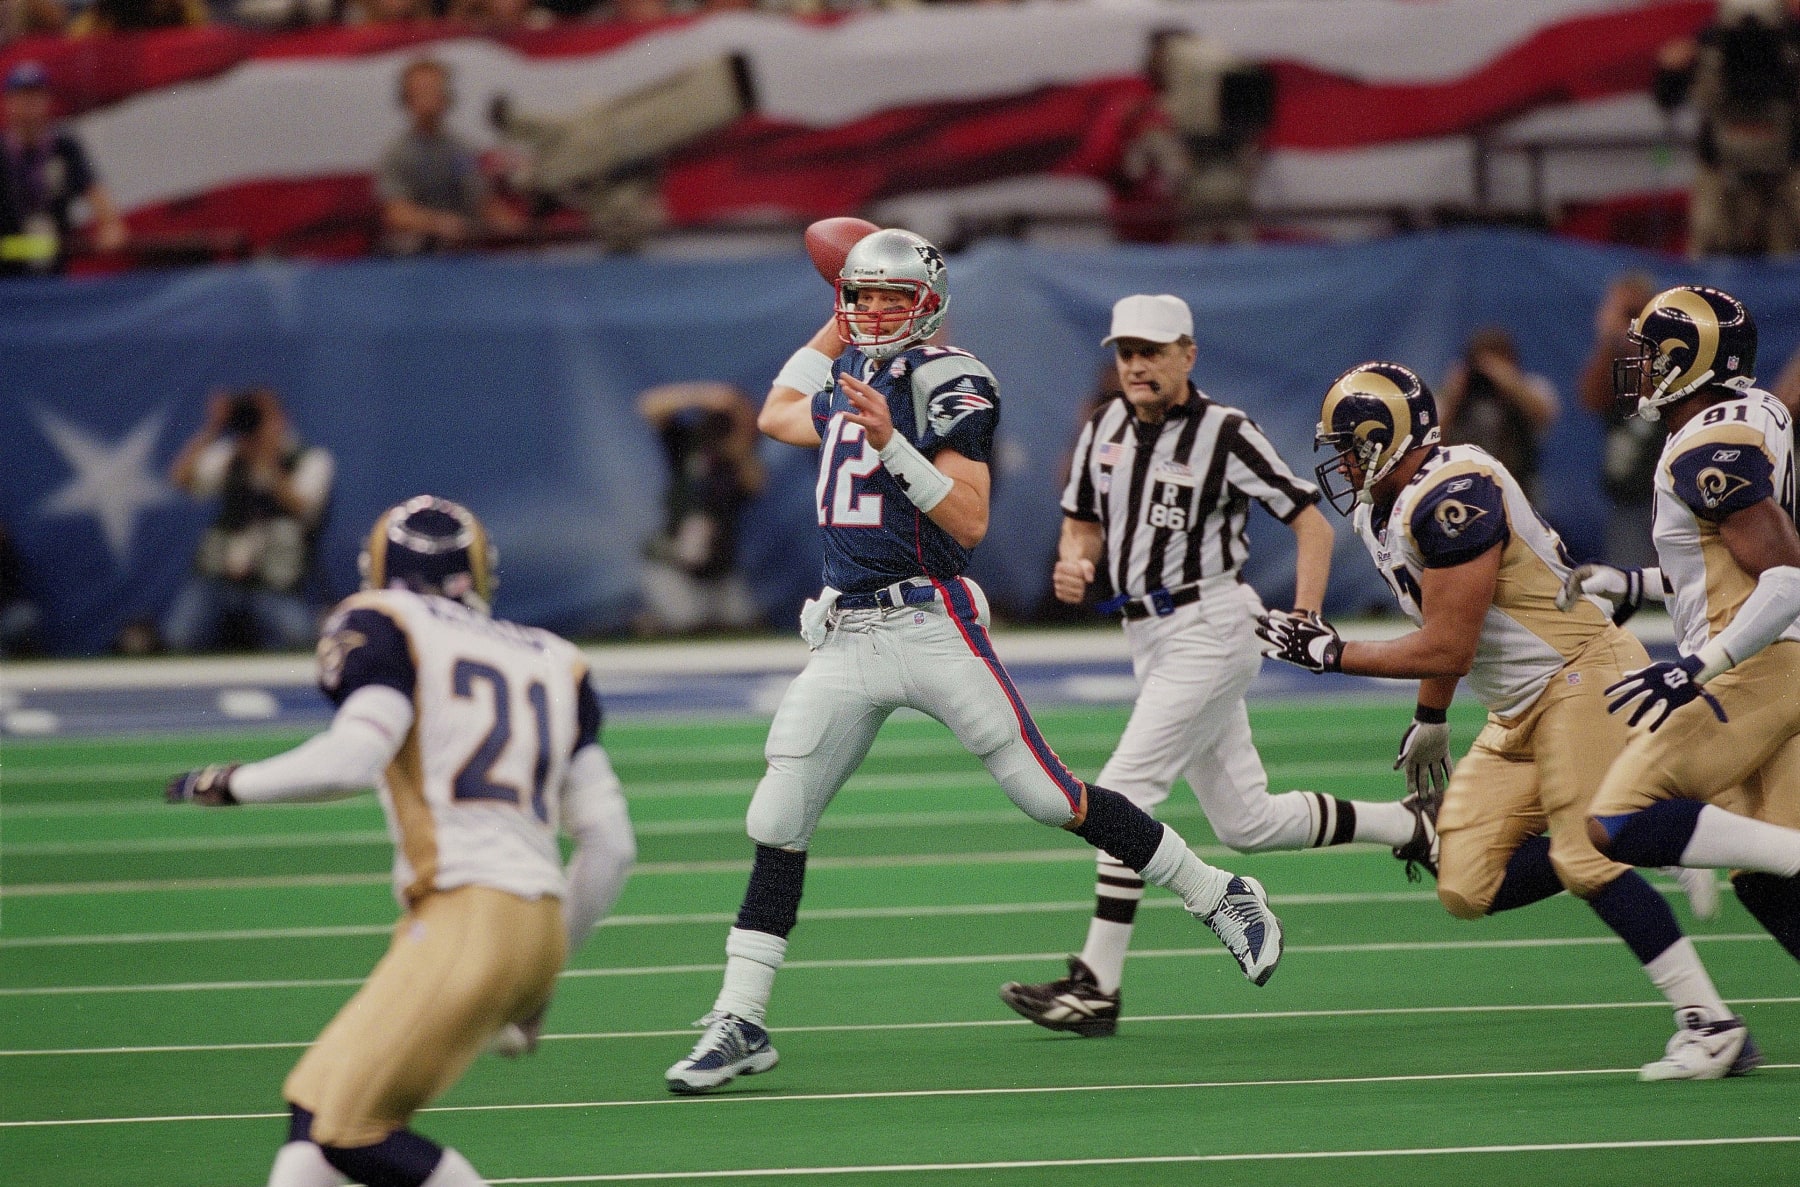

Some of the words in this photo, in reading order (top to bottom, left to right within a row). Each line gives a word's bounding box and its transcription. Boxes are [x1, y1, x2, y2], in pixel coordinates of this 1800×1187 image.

[1702, 405, 1748, 426] 91
[816, 411, 884, 528] 12
[1162, 482, 1179, 506] R
[1150, 503, 1186, 531] 86
[452, 657, 550, 824] 21
